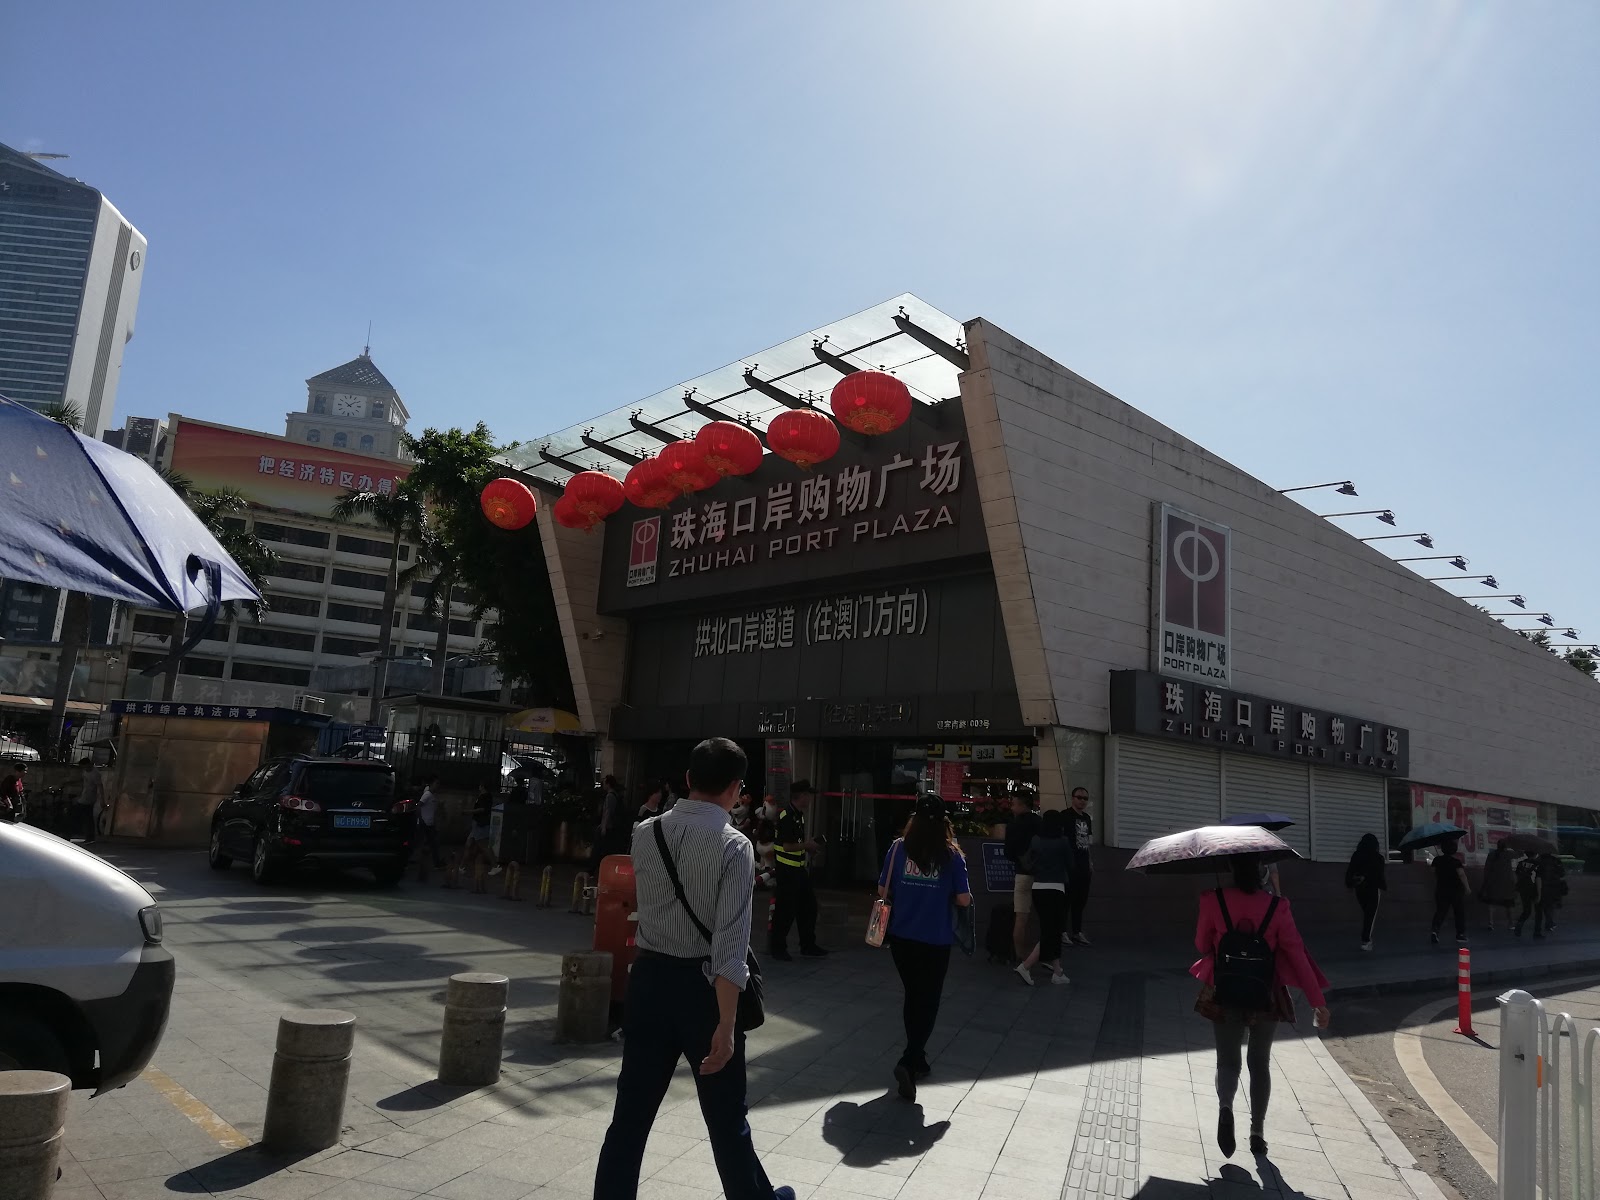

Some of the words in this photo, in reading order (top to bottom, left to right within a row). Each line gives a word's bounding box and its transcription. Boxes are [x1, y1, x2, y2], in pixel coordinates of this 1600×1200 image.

[669, 440, 963, 551] 珠海口岸购物广场
[668, 543, 756, 577] ZHUHAI
[768, 528, 840, 559] PORT
[852, 505, 955, 543] PLAZA
[1164, 630, 1226, 667] 口岸购物广场
[1164, 657, 1191, 673] PORT
[1192, 664, 1227, 681] PLAZA
[125, 702, 258, 719] 拱北综合执法岗亭
[1165, 682, 1399, 756] 珠海口岸购物广场
[1165, 719, 1256, 747] ZHUHAI
[1278, 740, 1327, 759] PORT
[1344, 751, 1399, 770] PLAZA
